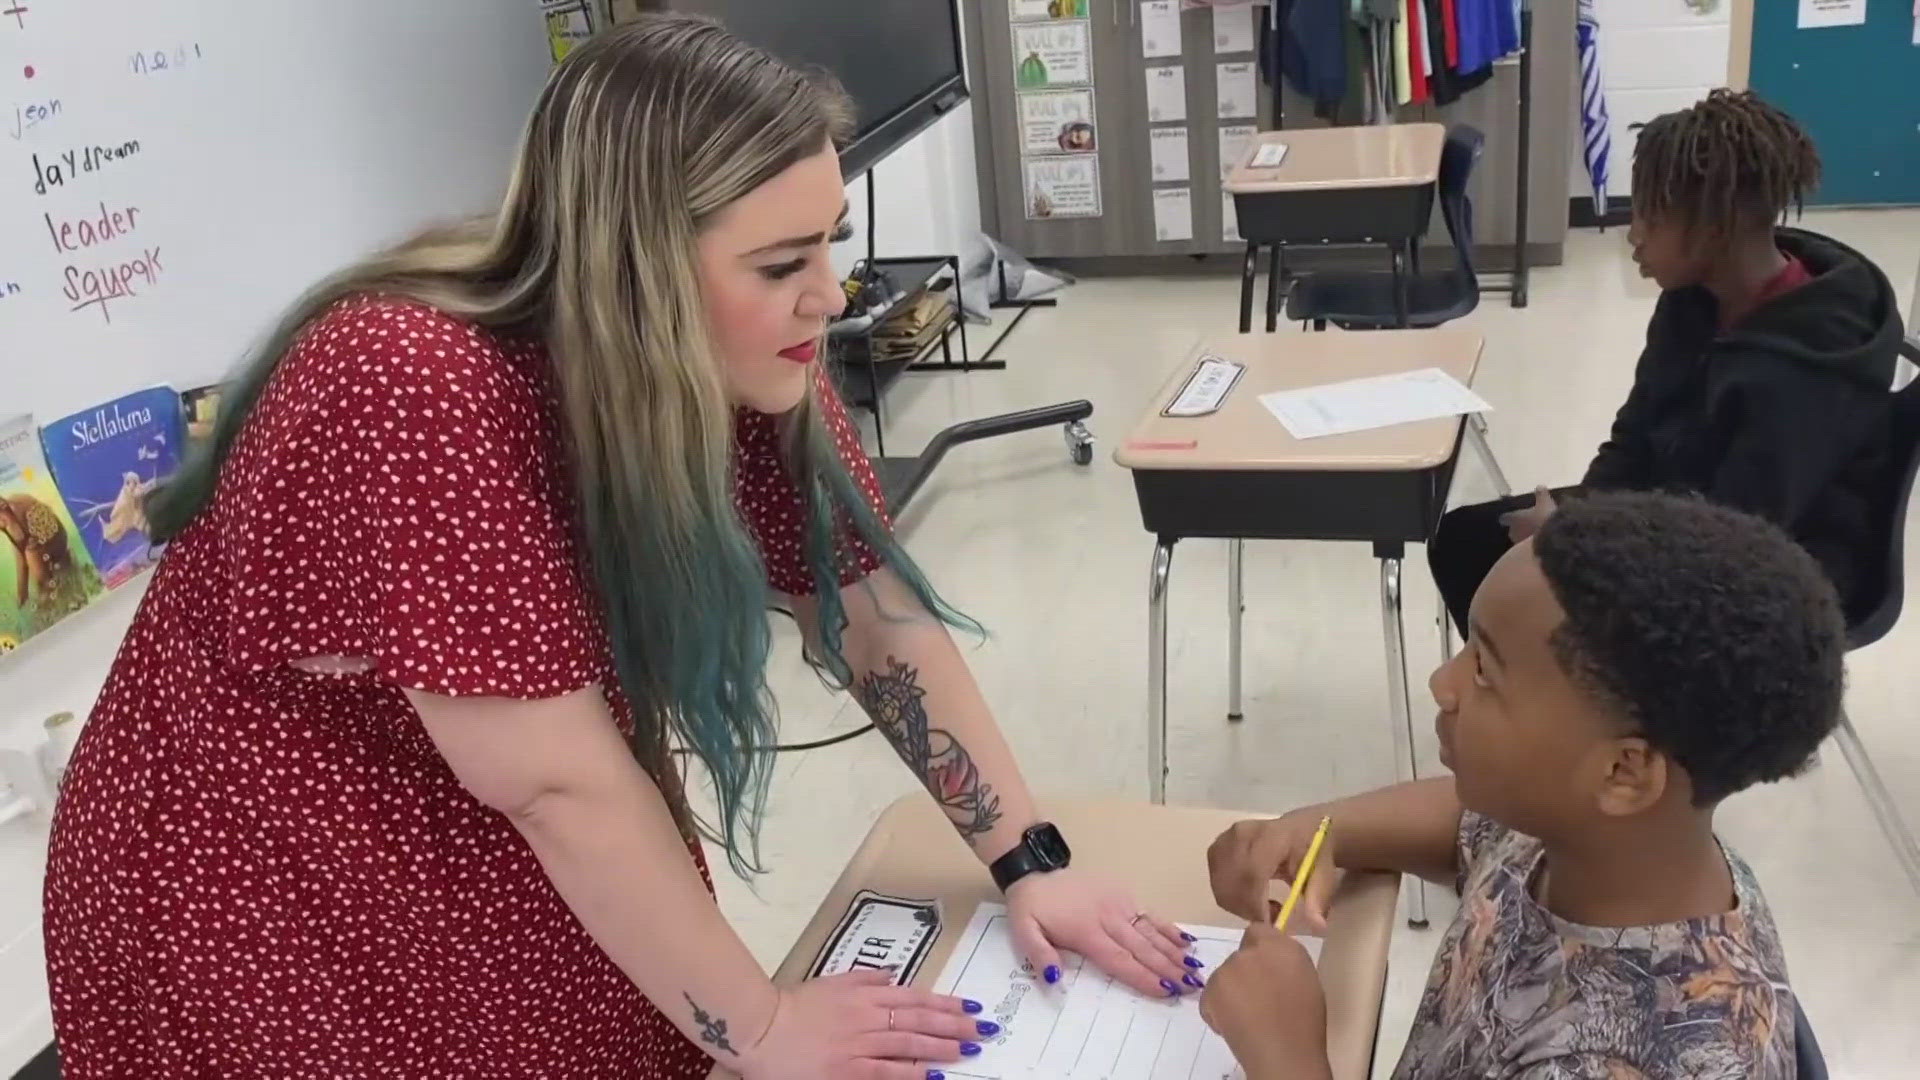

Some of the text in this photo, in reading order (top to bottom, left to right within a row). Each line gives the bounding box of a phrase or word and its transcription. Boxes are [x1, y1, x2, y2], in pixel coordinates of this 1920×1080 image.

[33, 139, 141, 195] daydream
[44, 201, 141, 254] leader
[71, 404, 153, 452] Stellaluna
